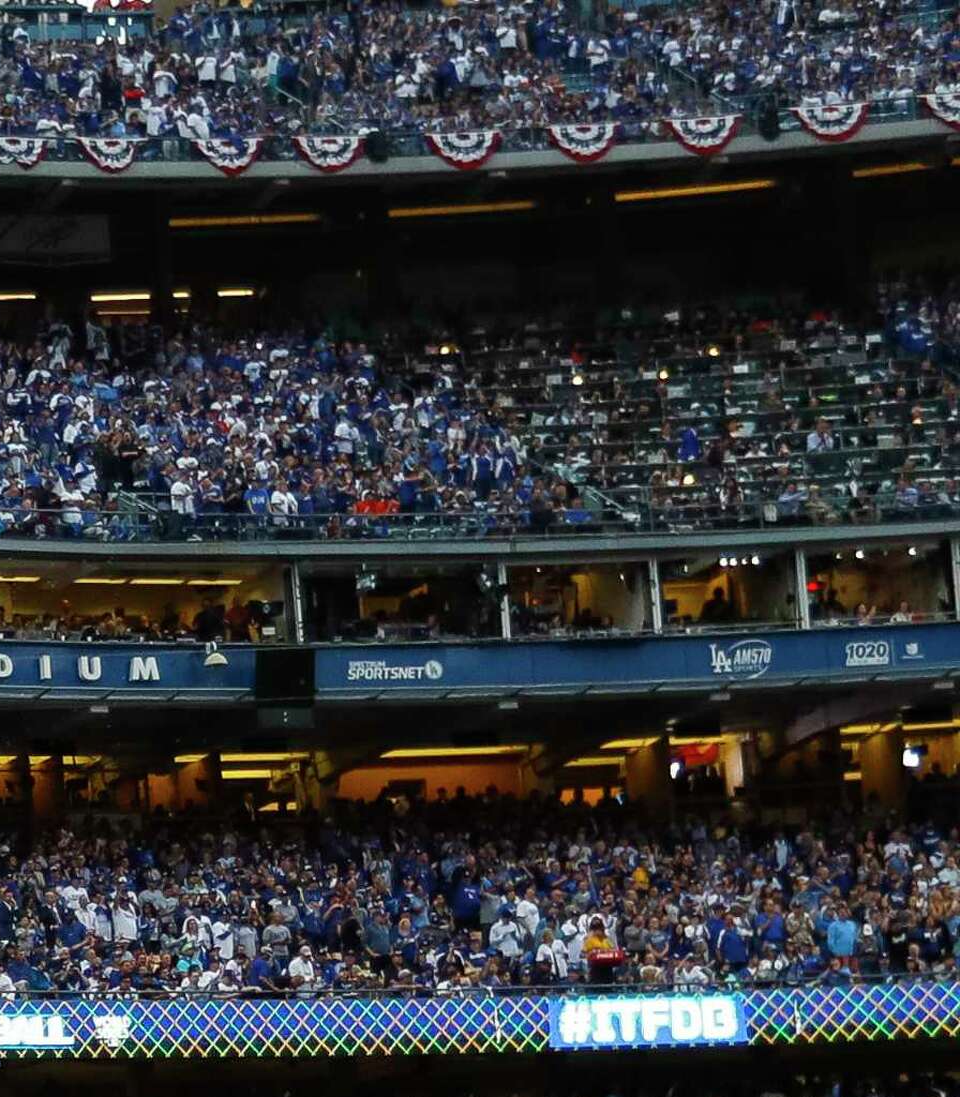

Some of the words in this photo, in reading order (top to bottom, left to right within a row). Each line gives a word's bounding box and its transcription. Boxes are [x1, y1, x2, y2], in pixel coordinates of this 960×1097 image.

[733, 648, 772, 665] AM570
[847, 642, 888, 659] 1020
[347, 666, 425, 680] SPORTSNET
[558, 997, 738, 1043] #ITFDB
